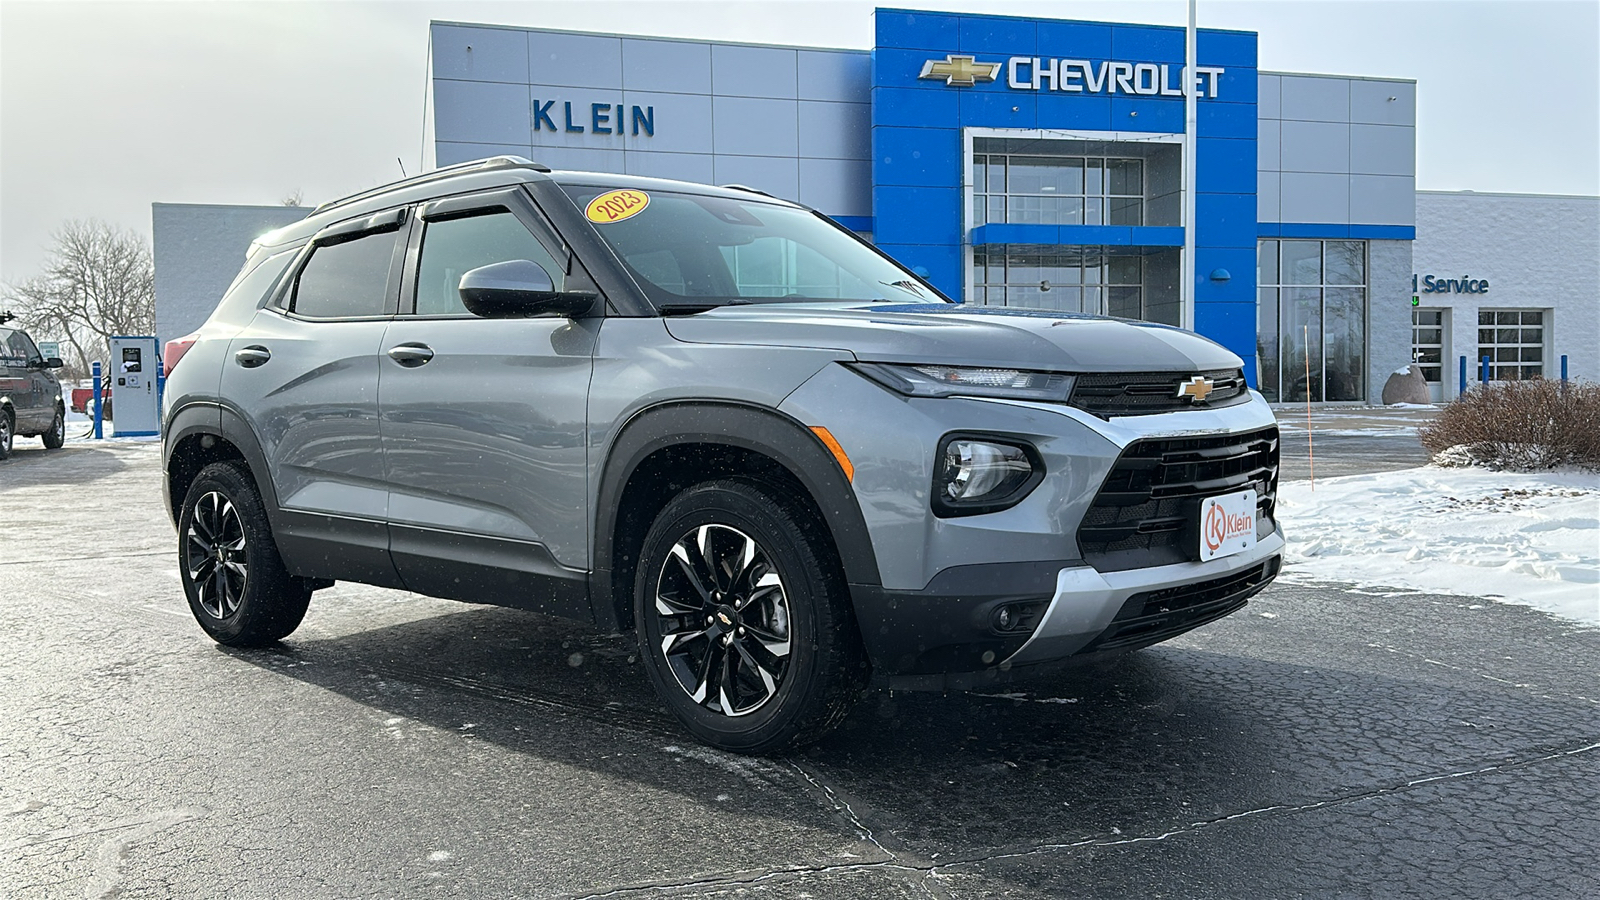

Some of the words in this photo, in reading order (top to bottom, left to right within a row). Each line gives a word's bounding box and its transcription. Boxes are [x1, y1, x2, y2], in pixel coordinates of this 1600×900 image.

[533, 99, 654, 137] KLEIN
[596, 191, 641, 220] 2023
[1424, 274, 1489, 294] Service
[1227, 511, 1252, 535] Klein
